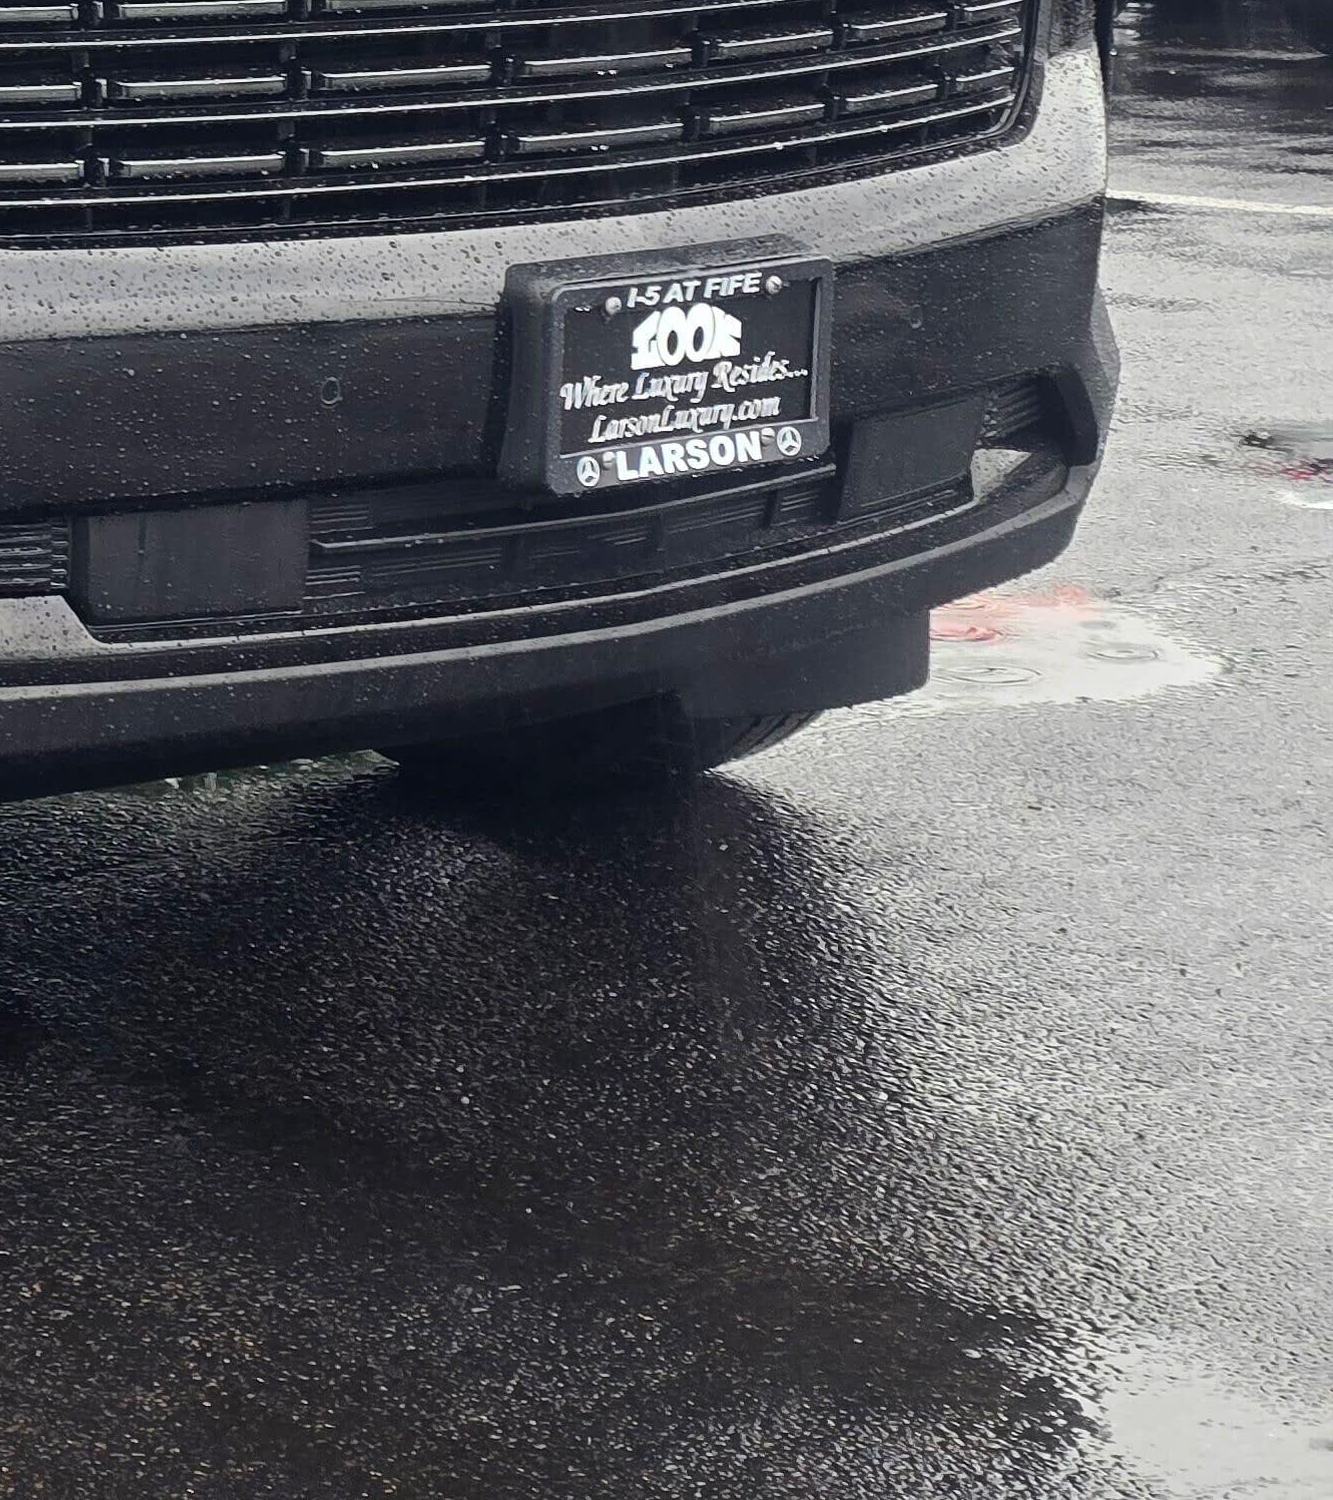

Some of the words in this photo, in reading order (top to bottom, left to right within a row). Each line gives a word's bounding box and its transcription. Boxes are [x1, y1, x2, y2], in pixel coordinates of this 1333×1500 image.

[626, 285, 663, 308] I-5
[663, 280, 701, 304] AT
[703, 272, 763, 299] FIFE
[559, 374, 630, 411] Where
[631, 371, 710, 404] Luxury
[587, 396, 781, 444] LarsonLuxury.com
[615, 430, 763, 482] LARSON
